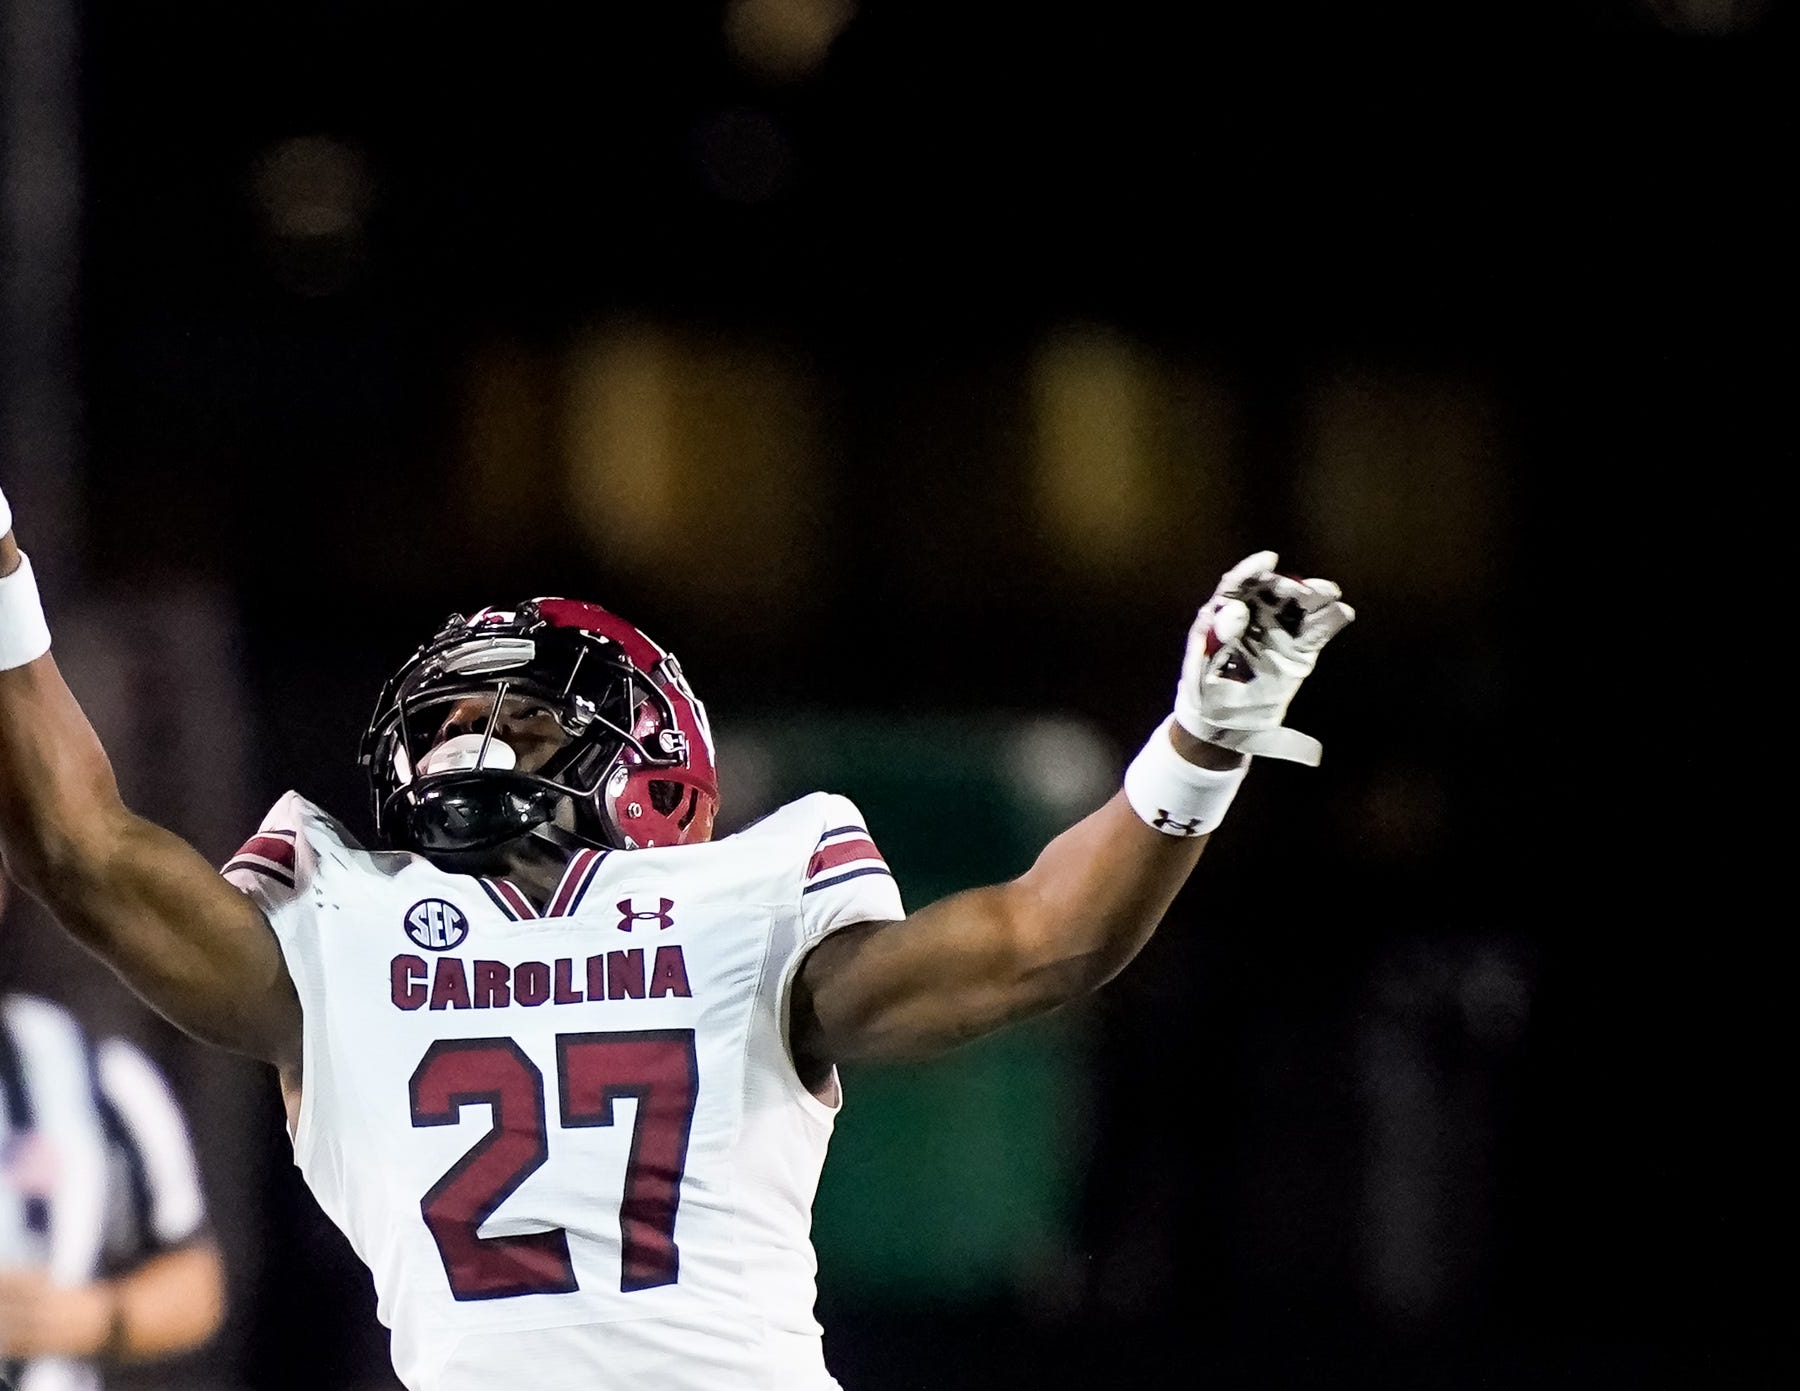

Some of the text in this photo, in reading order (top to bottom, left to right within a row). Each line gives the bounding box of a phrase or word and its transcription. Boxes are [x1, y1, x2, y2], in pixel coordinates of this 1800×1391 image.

[408, 901, 464, 948] SEC
[390, 945, 693, 1011] CAROLINA
[408, 1028, 700, 1301] 27
